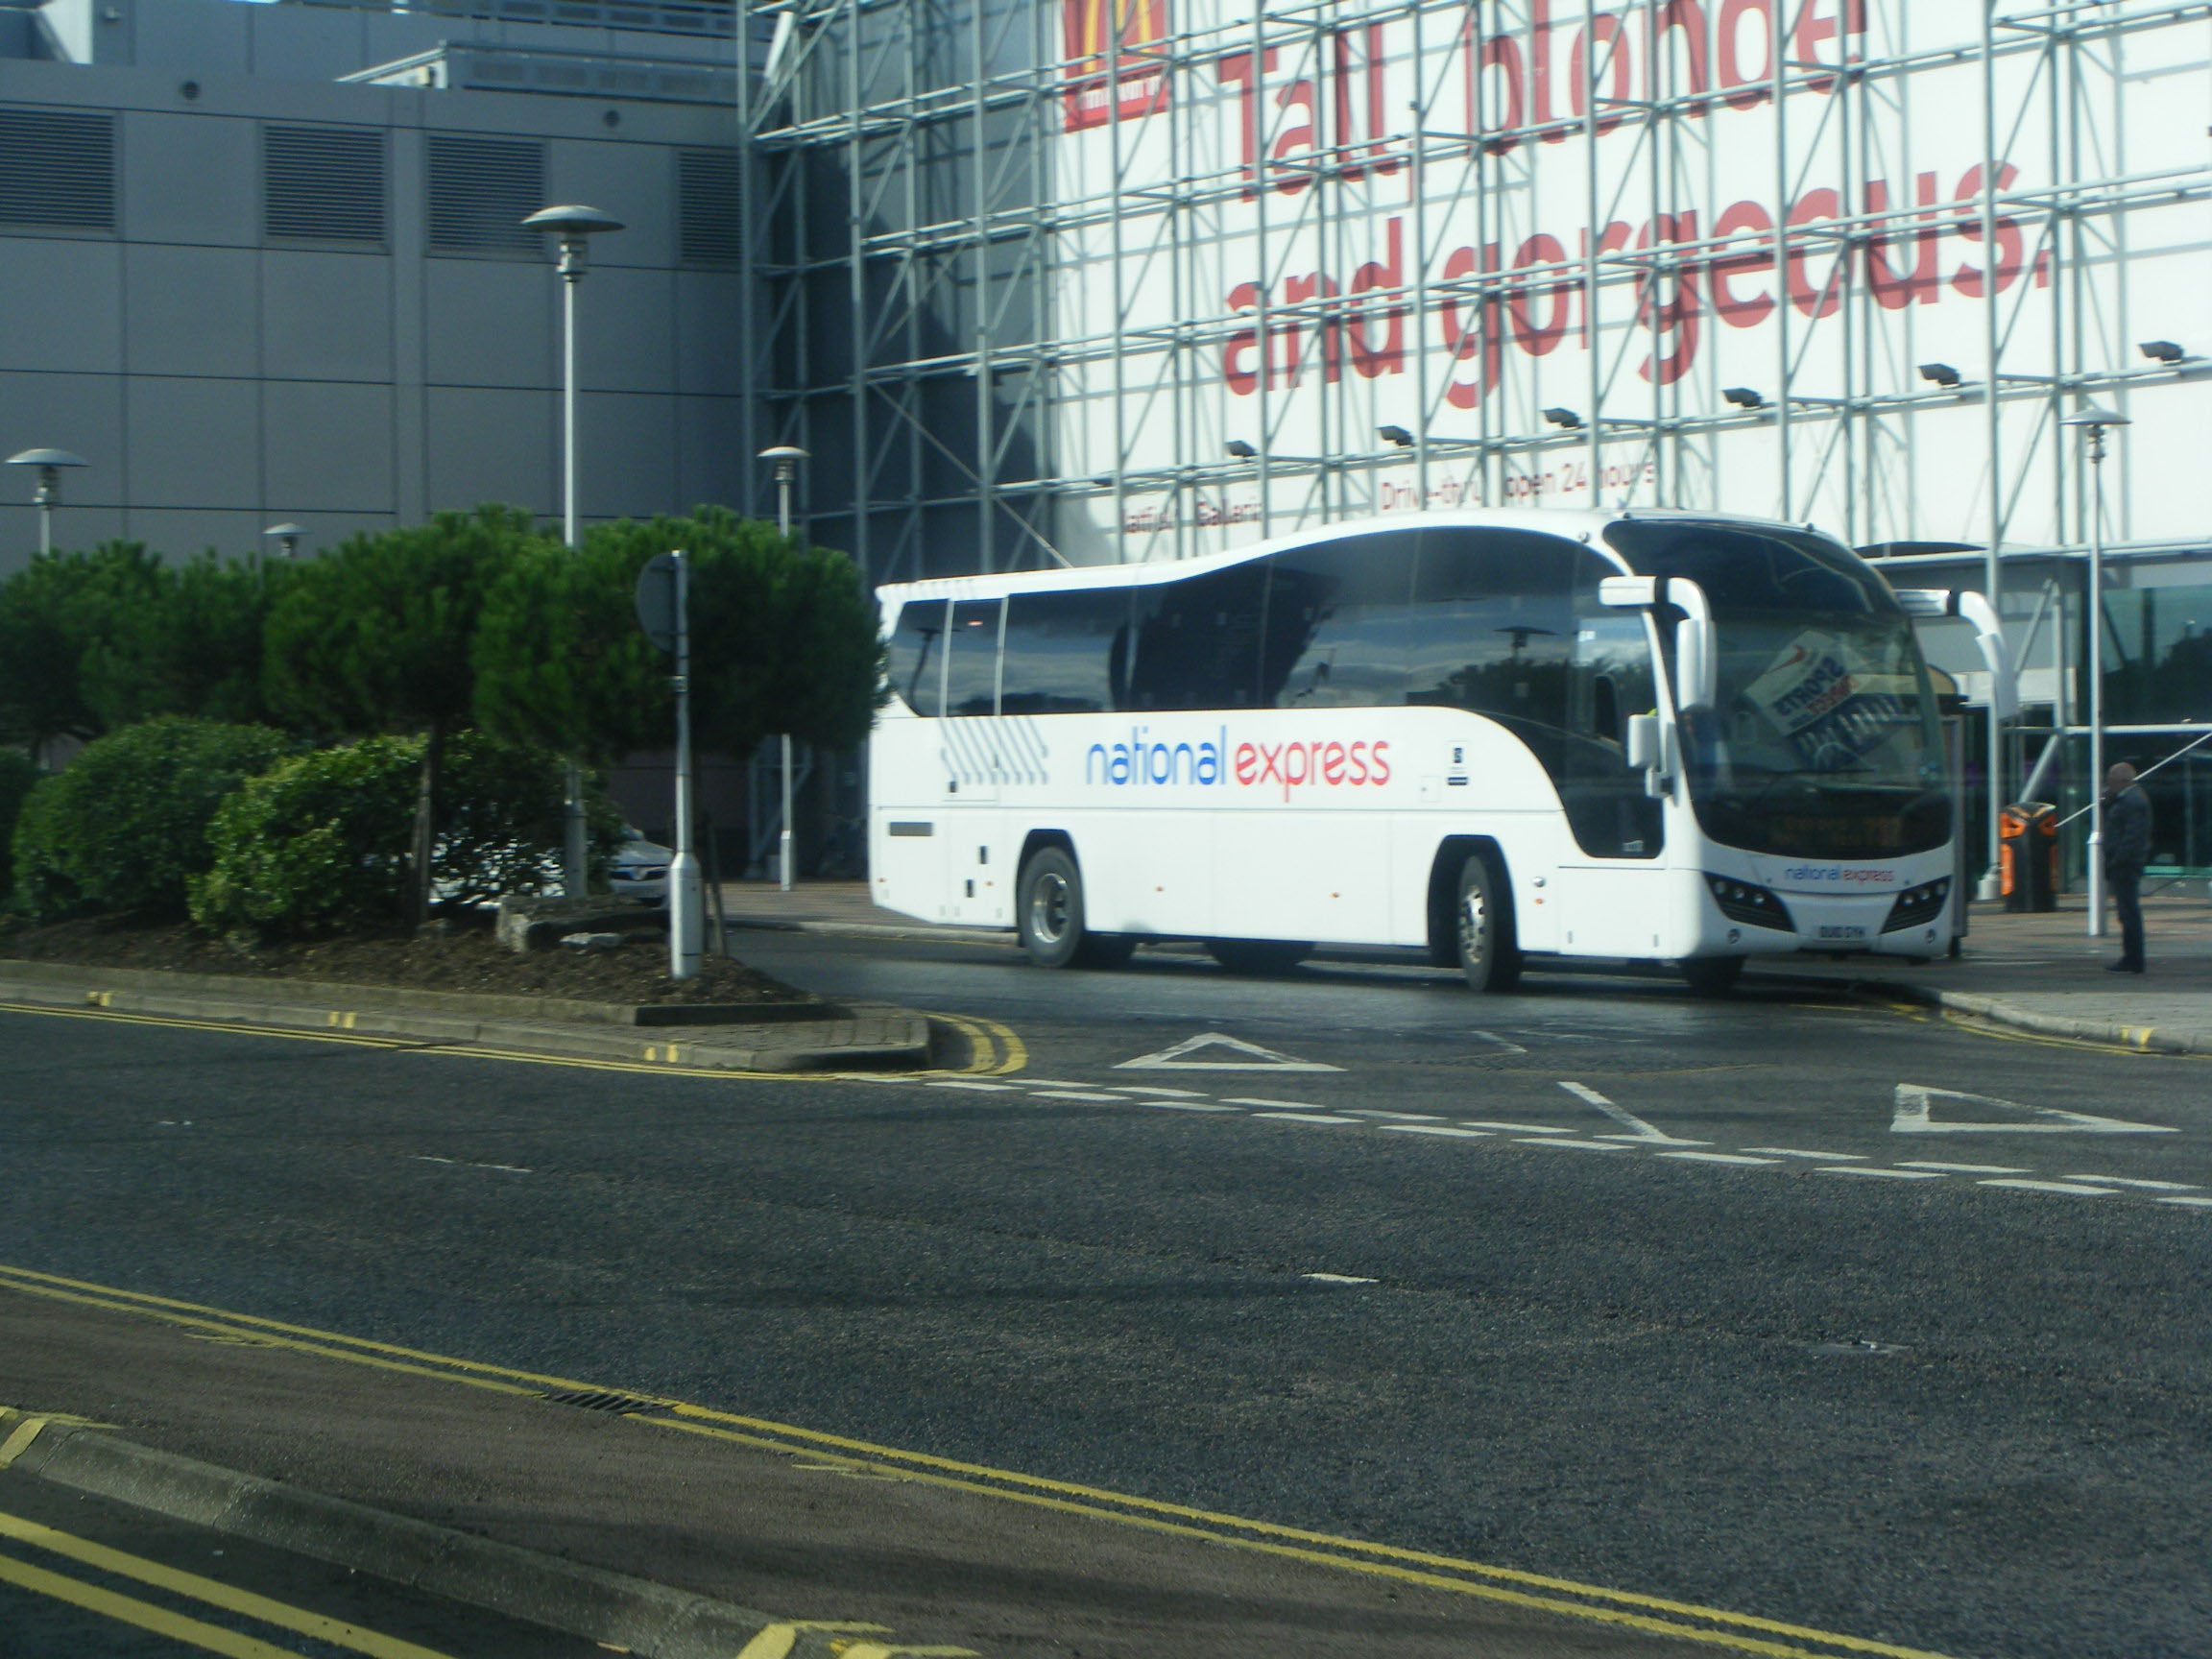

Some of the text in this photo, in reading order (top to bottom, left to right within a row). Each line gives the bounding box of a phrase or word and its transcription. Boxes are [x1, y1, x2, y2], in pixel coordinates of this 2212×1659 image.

[1223, 217, 1404, 396] and
[1503, 473, 1556, 506] open
[1562, 463, 1586, 492] 24
[1086, 725, 1390, 803] national express
[1785, 864, 1894, 885] national express
